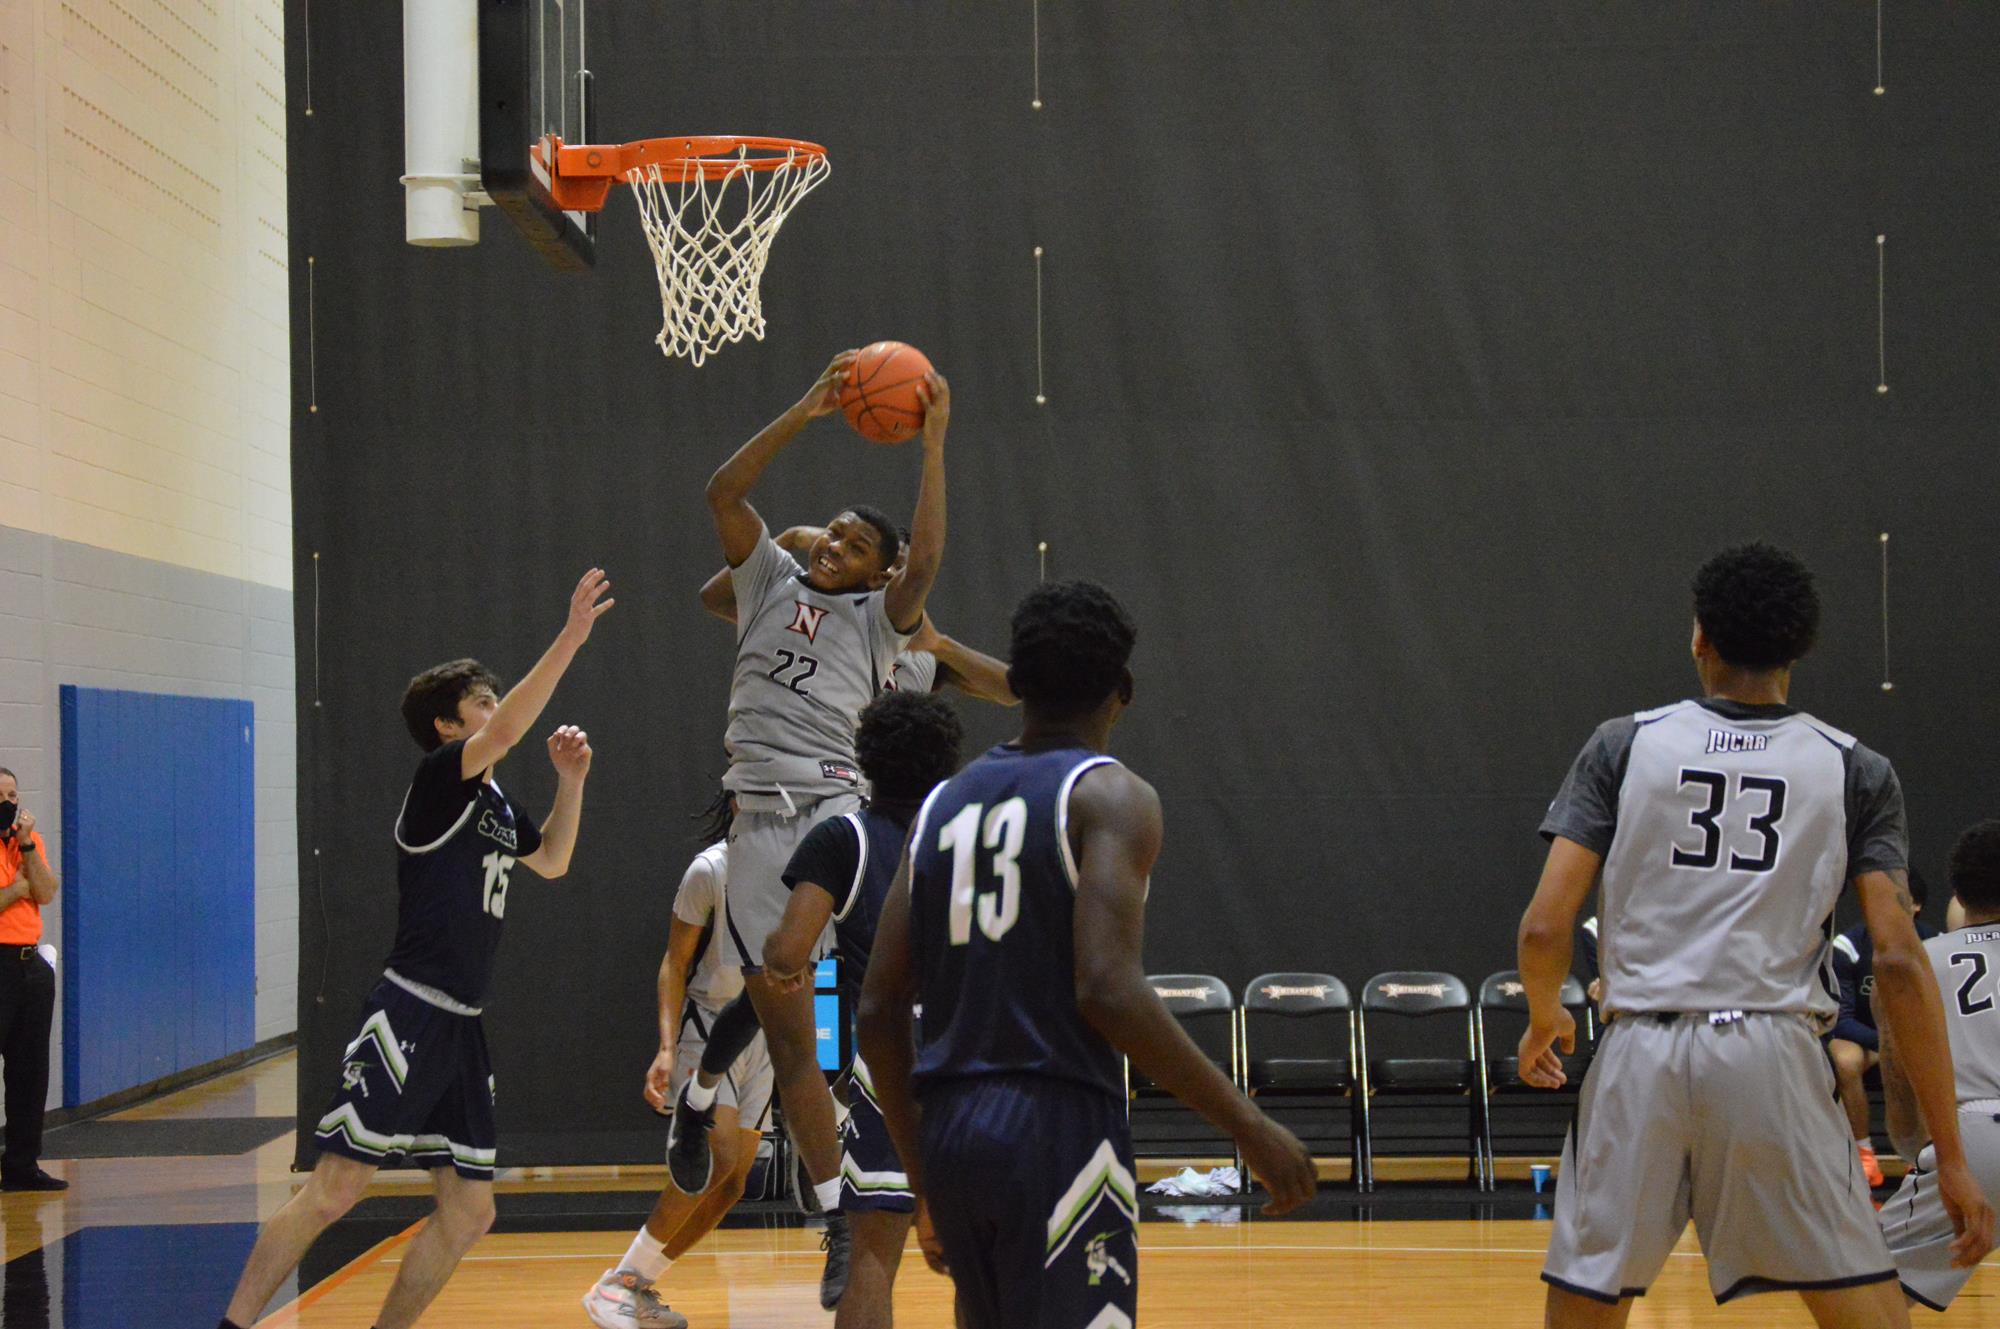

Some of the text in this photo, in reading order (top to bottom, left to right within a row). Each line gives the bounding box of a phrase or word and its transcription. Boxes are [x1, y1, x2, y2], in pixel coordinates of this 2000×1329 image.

[785, 600, 829, 645] N
[768, 648, 818, 697] 22
[1705, 729, 1768, 754] NJCAA
[1670, 766, 1789, 875] 33
[482, 850, 516, 919] 15
[938, 796, 1028, 946] 13
[1949, 951, 2000, 1018] 2
